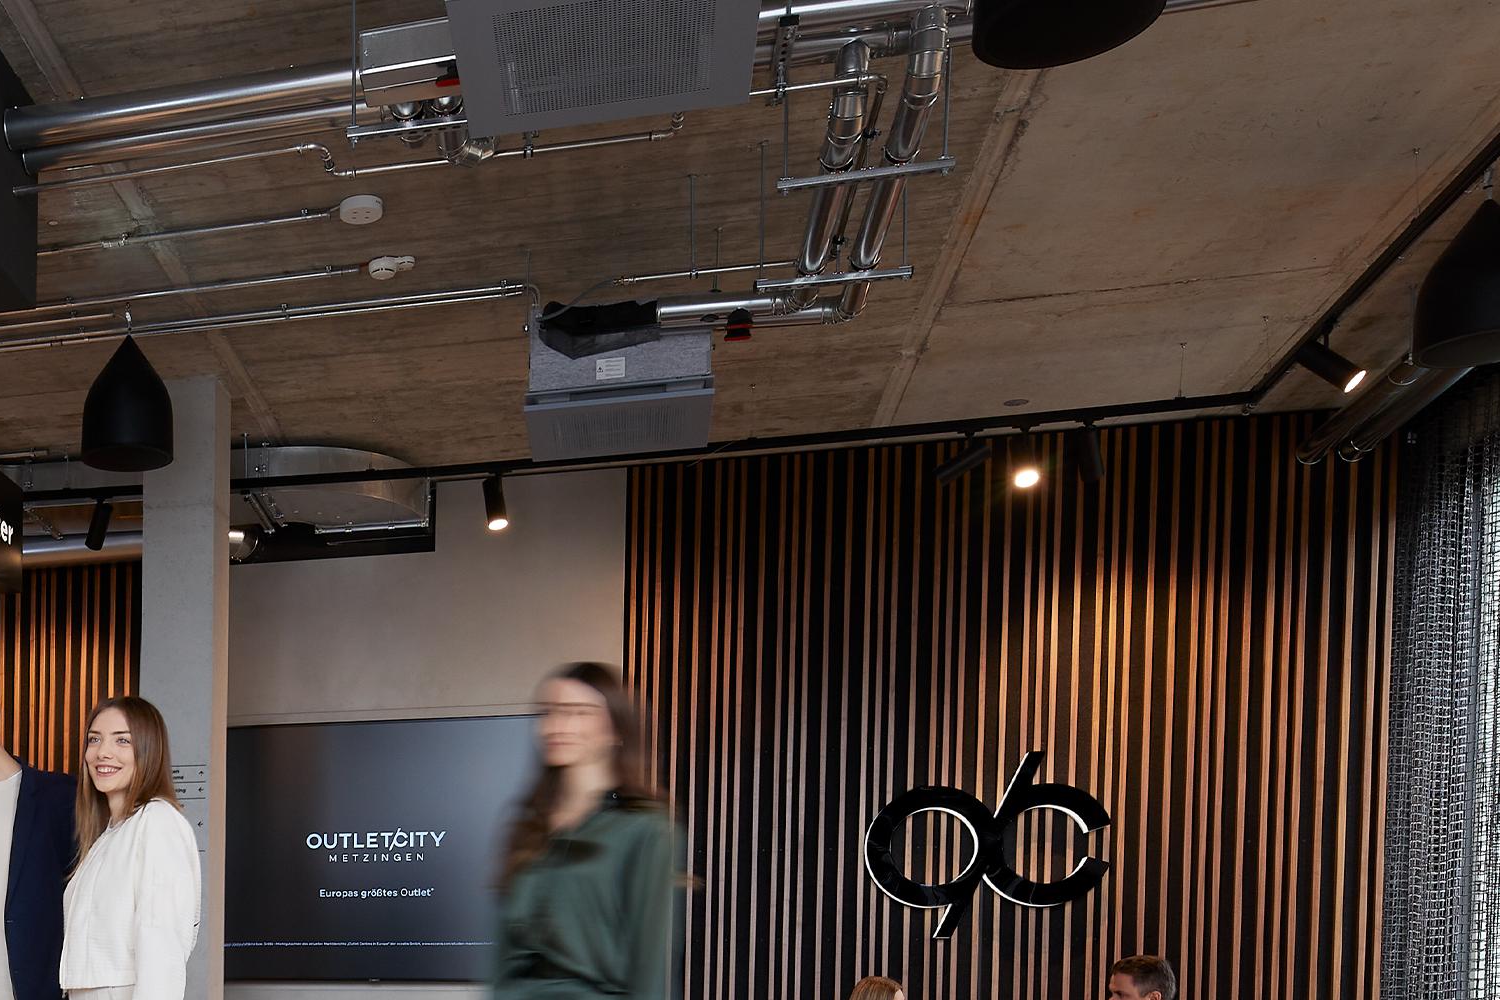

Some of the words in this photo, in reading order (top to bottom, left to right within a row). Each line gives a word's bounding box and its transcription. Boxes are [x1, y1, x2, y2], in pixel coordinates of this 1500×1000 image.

[329, 853, 425, 863] METZINGEN
[319, 889, 359, 899] Europas
[360, 888, 398, 899] größtes
